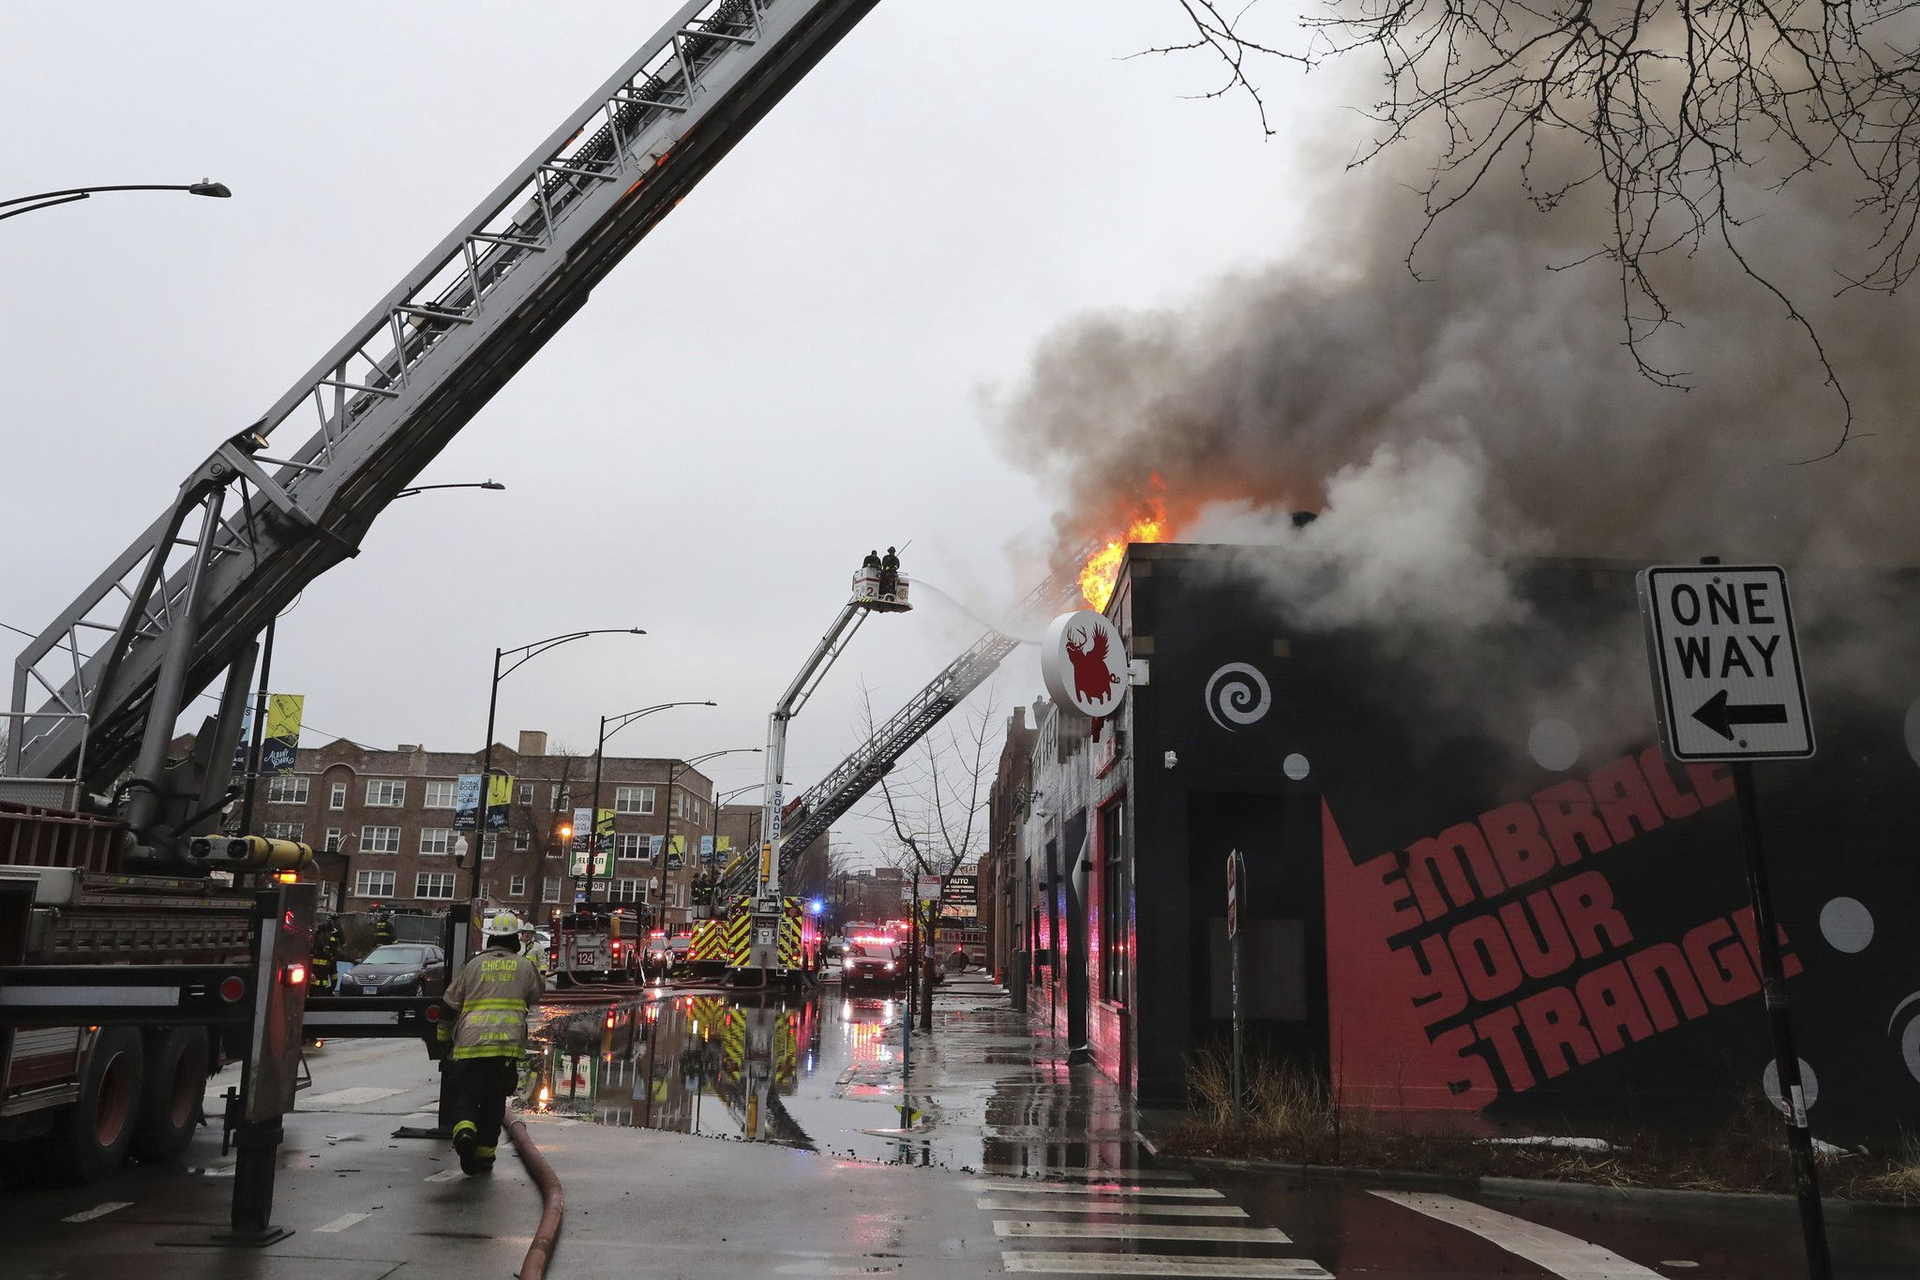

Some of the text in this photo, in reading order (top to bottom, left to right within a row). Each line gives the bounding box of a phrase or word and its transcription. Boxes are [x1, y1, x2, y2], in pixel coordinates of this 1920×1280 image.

[1671, 583, 1775, 626] ONE
[1674, 635, 1781, 679] WAY
[772, 790, 782, 831] SQUAD
[1362, 746, 1738, 933] EMBRACE
[577, 882, 604, 890] LIOR
[482, 960, 518, 972] CHICAGO
[578, 953, 594, 964] 124
[1393, 870, 1635, 1027] YOUR
[1431, 904, 1804, 1110] STRANGE
